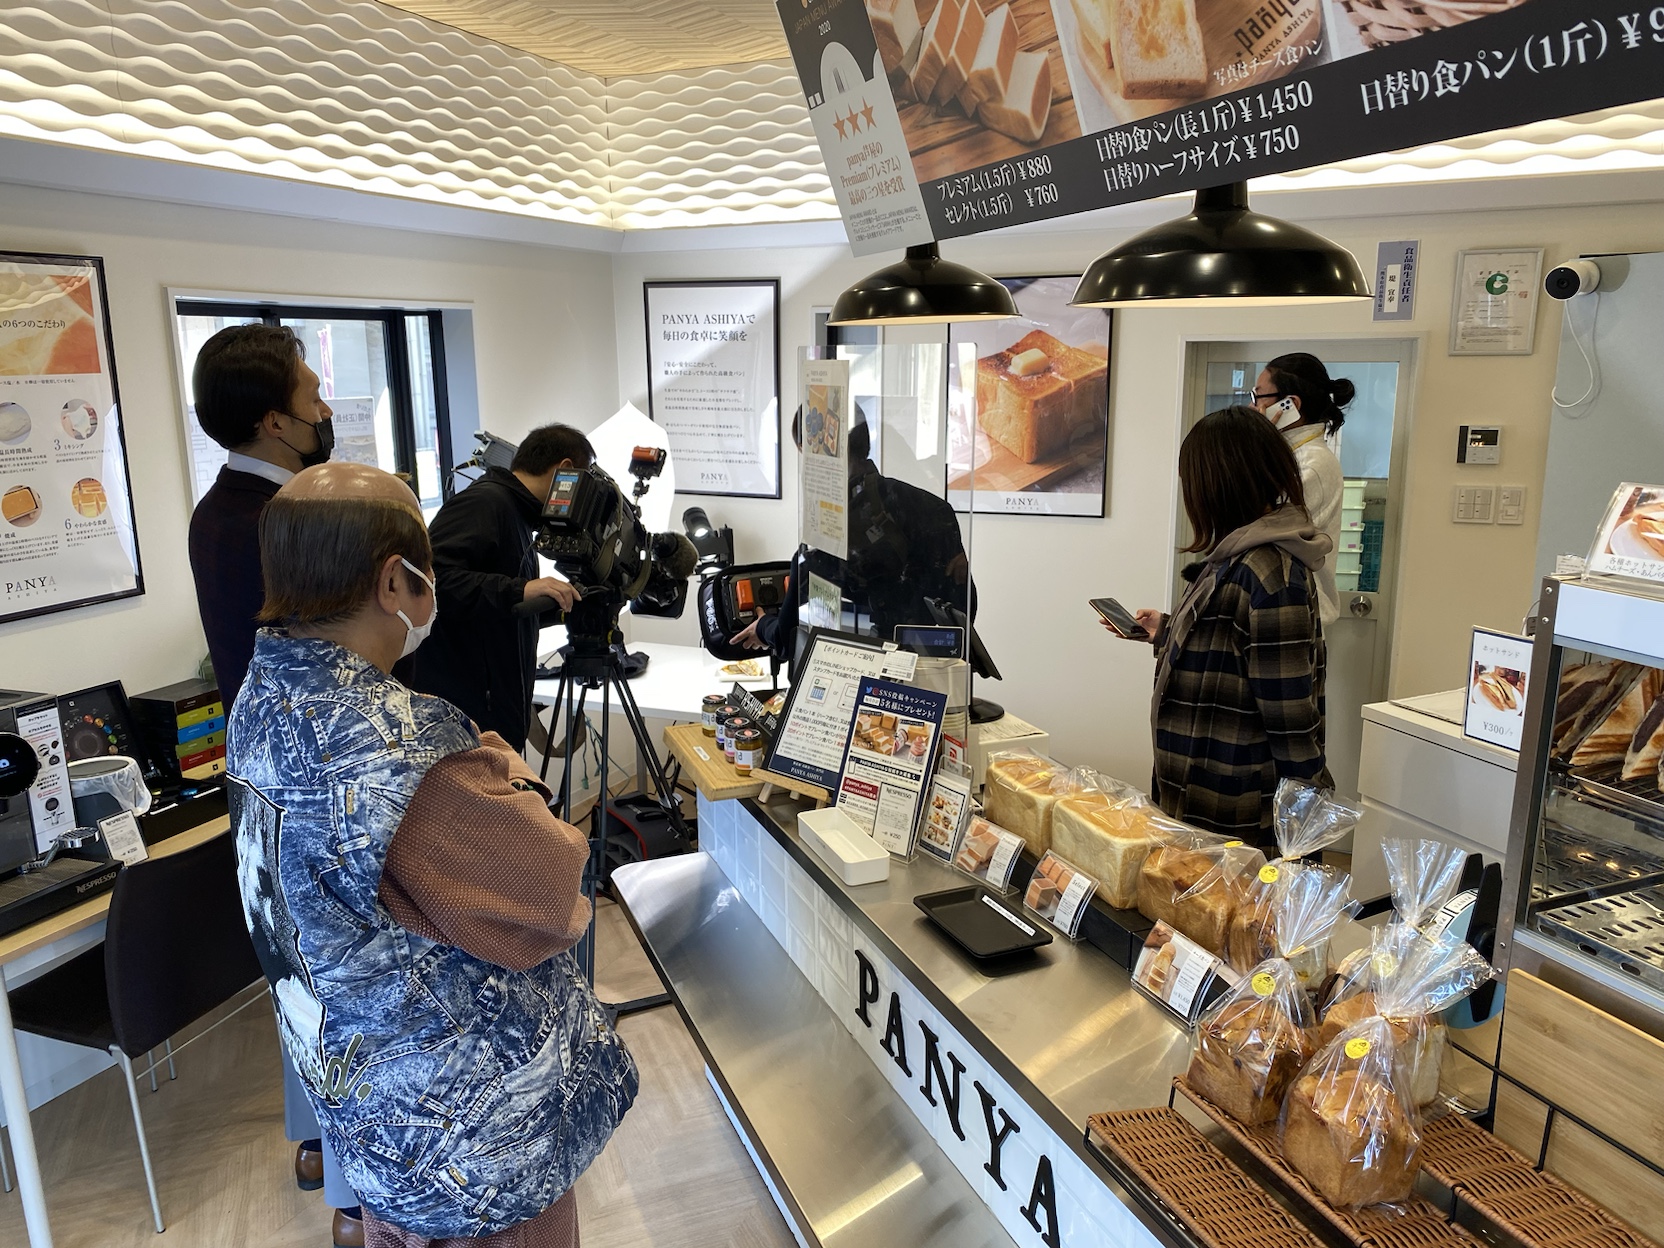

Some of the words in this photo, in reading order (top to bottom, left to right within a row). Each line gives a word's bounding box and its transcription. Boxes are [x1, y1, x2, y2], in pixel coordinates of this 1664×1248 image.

[818, 20, 831, 36] 2020
[1282, 8, 1314, 38] ASHIYA
[1024, 182, 1059, 208] ¥760
[662, 314, 700, 325] PANYA
[703, 313, 756, 325] ASHIYAで
[662, 330, 748, 342] 毎日の食卓に笑顔を
[53, 439, 62, 451] 3
[700, 472, 729, 480] PANYA
[1005, 497, 1040, 506] PANYA
[64, 518, 72, 530] 6
[6, 575, 57, 594] PANYA
[1482, 644, 1521, 659] ホットサンド
[886, 787, 912, 800] NESPRESSO
[75, 871, 117, 894] NESPRESSO
[1071, 878, 1087, 892] Select
[855, 949, 1061, 1248] PANYA
